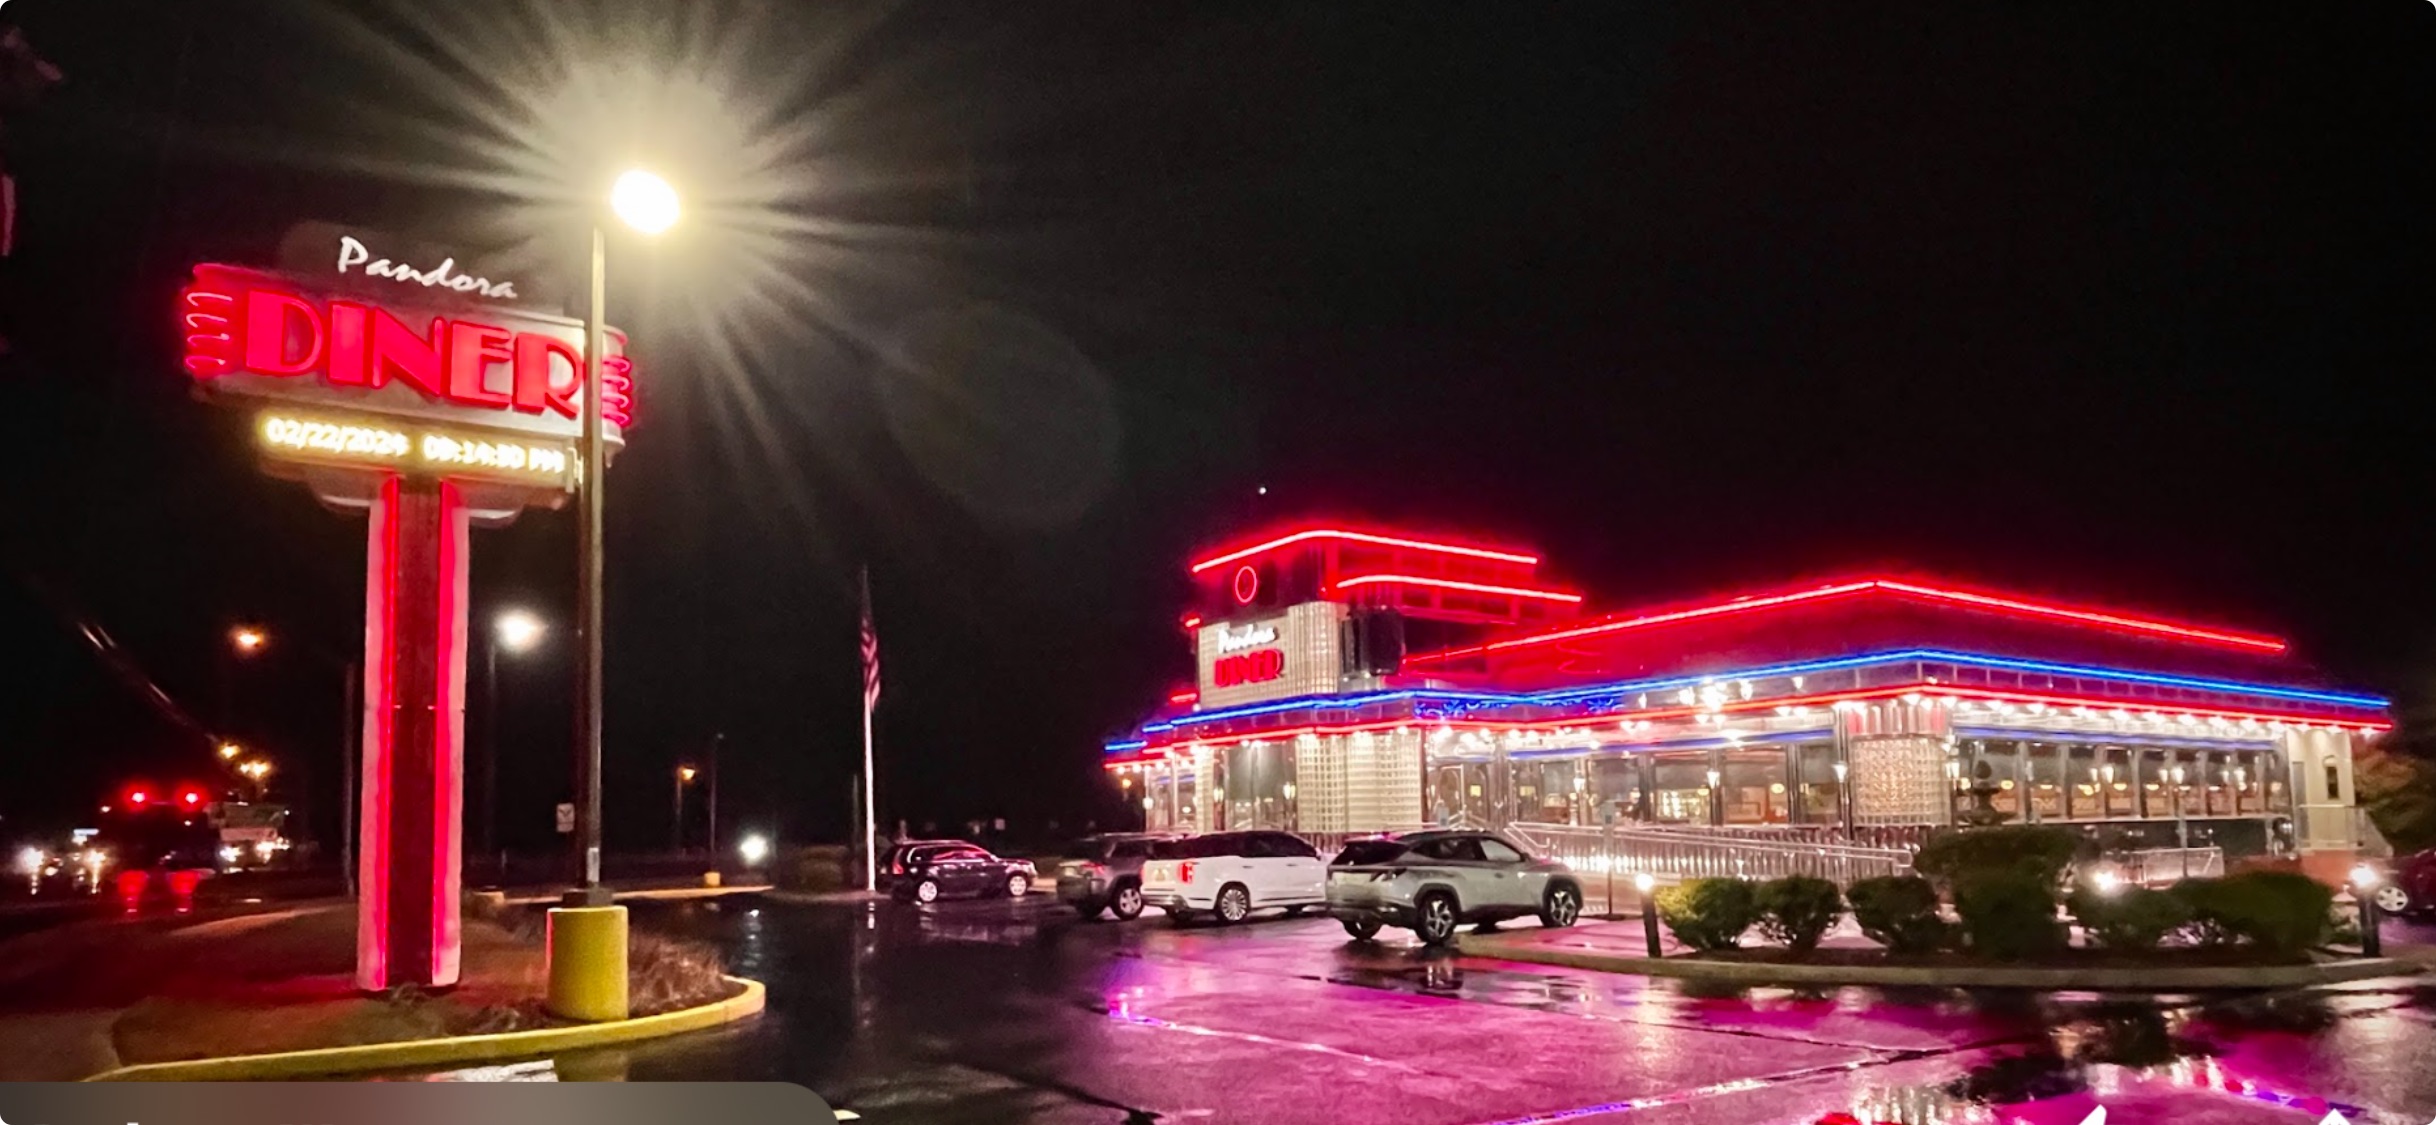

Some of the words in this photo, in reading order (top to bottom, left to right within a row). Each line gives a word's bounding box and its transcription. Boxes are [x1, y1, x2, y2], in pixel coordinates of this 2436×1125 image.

[338, 236, 517, 298] Pandora
[246, 289, 585, 420] DINER
[265, 417, 410, 457] 02/22/2024
[528, 447, 565, 473] PM
[1214, 649, 1284, 689] DINER
